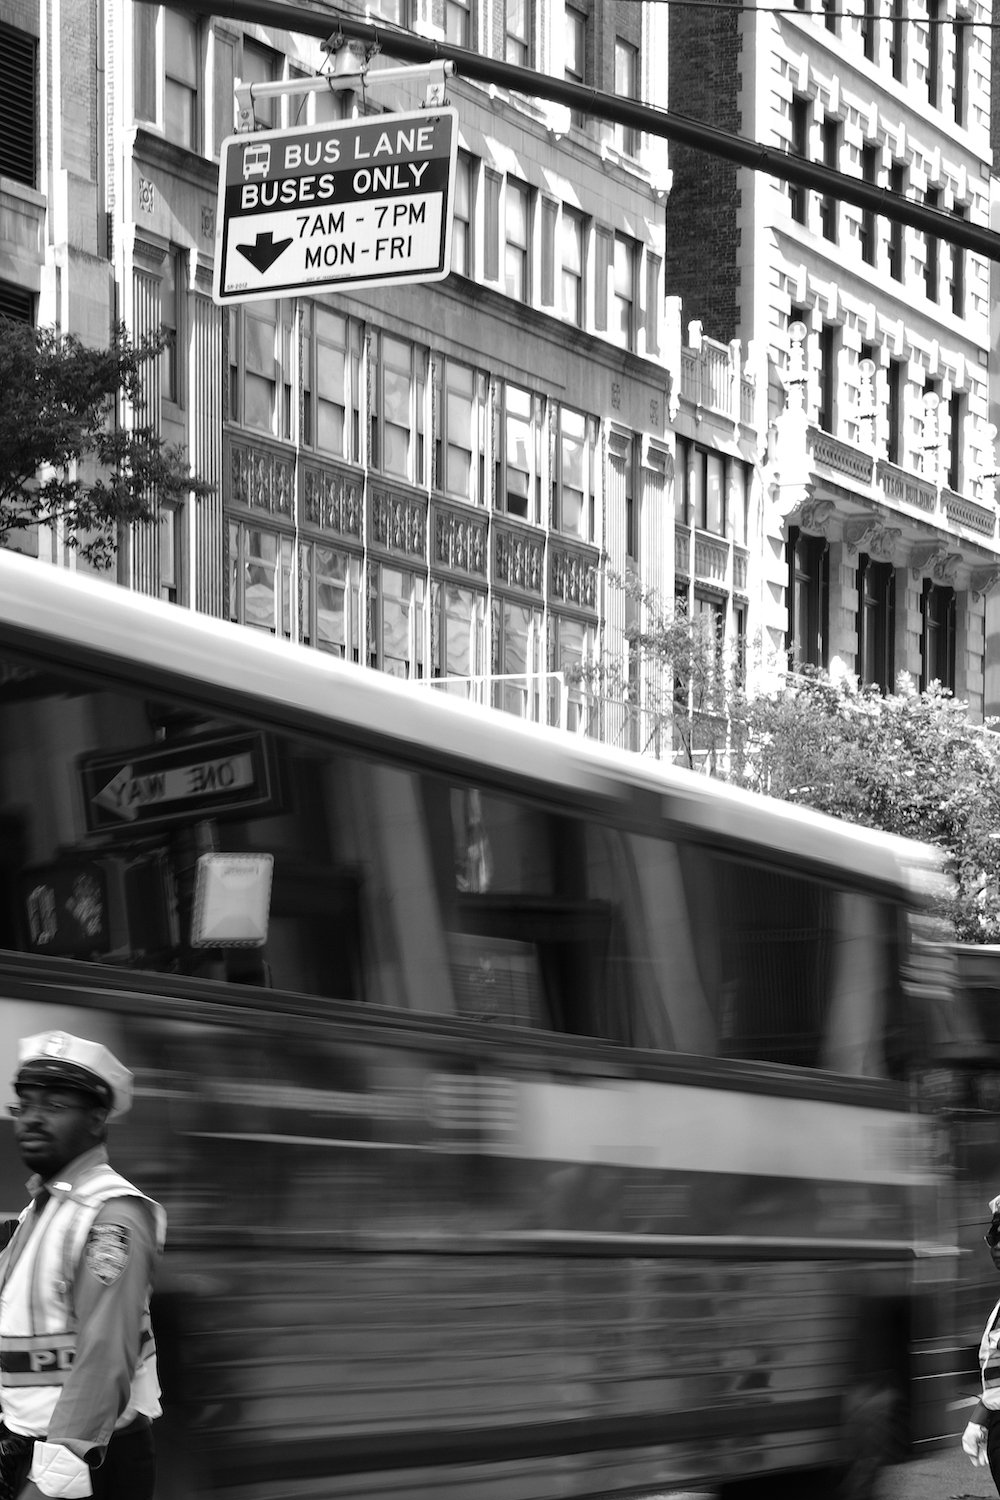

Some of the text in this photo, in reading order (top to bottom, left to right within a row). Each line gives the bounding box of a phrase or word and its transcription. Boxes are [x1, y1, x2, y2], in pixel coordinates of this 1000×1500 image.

[284, 126, 435, 170] BUS LANE
[240, 161, 430, 210] BUSES ONLY
[296, 211, 345, 239] 7AM
[374, 201, 427, 229] 7PM
